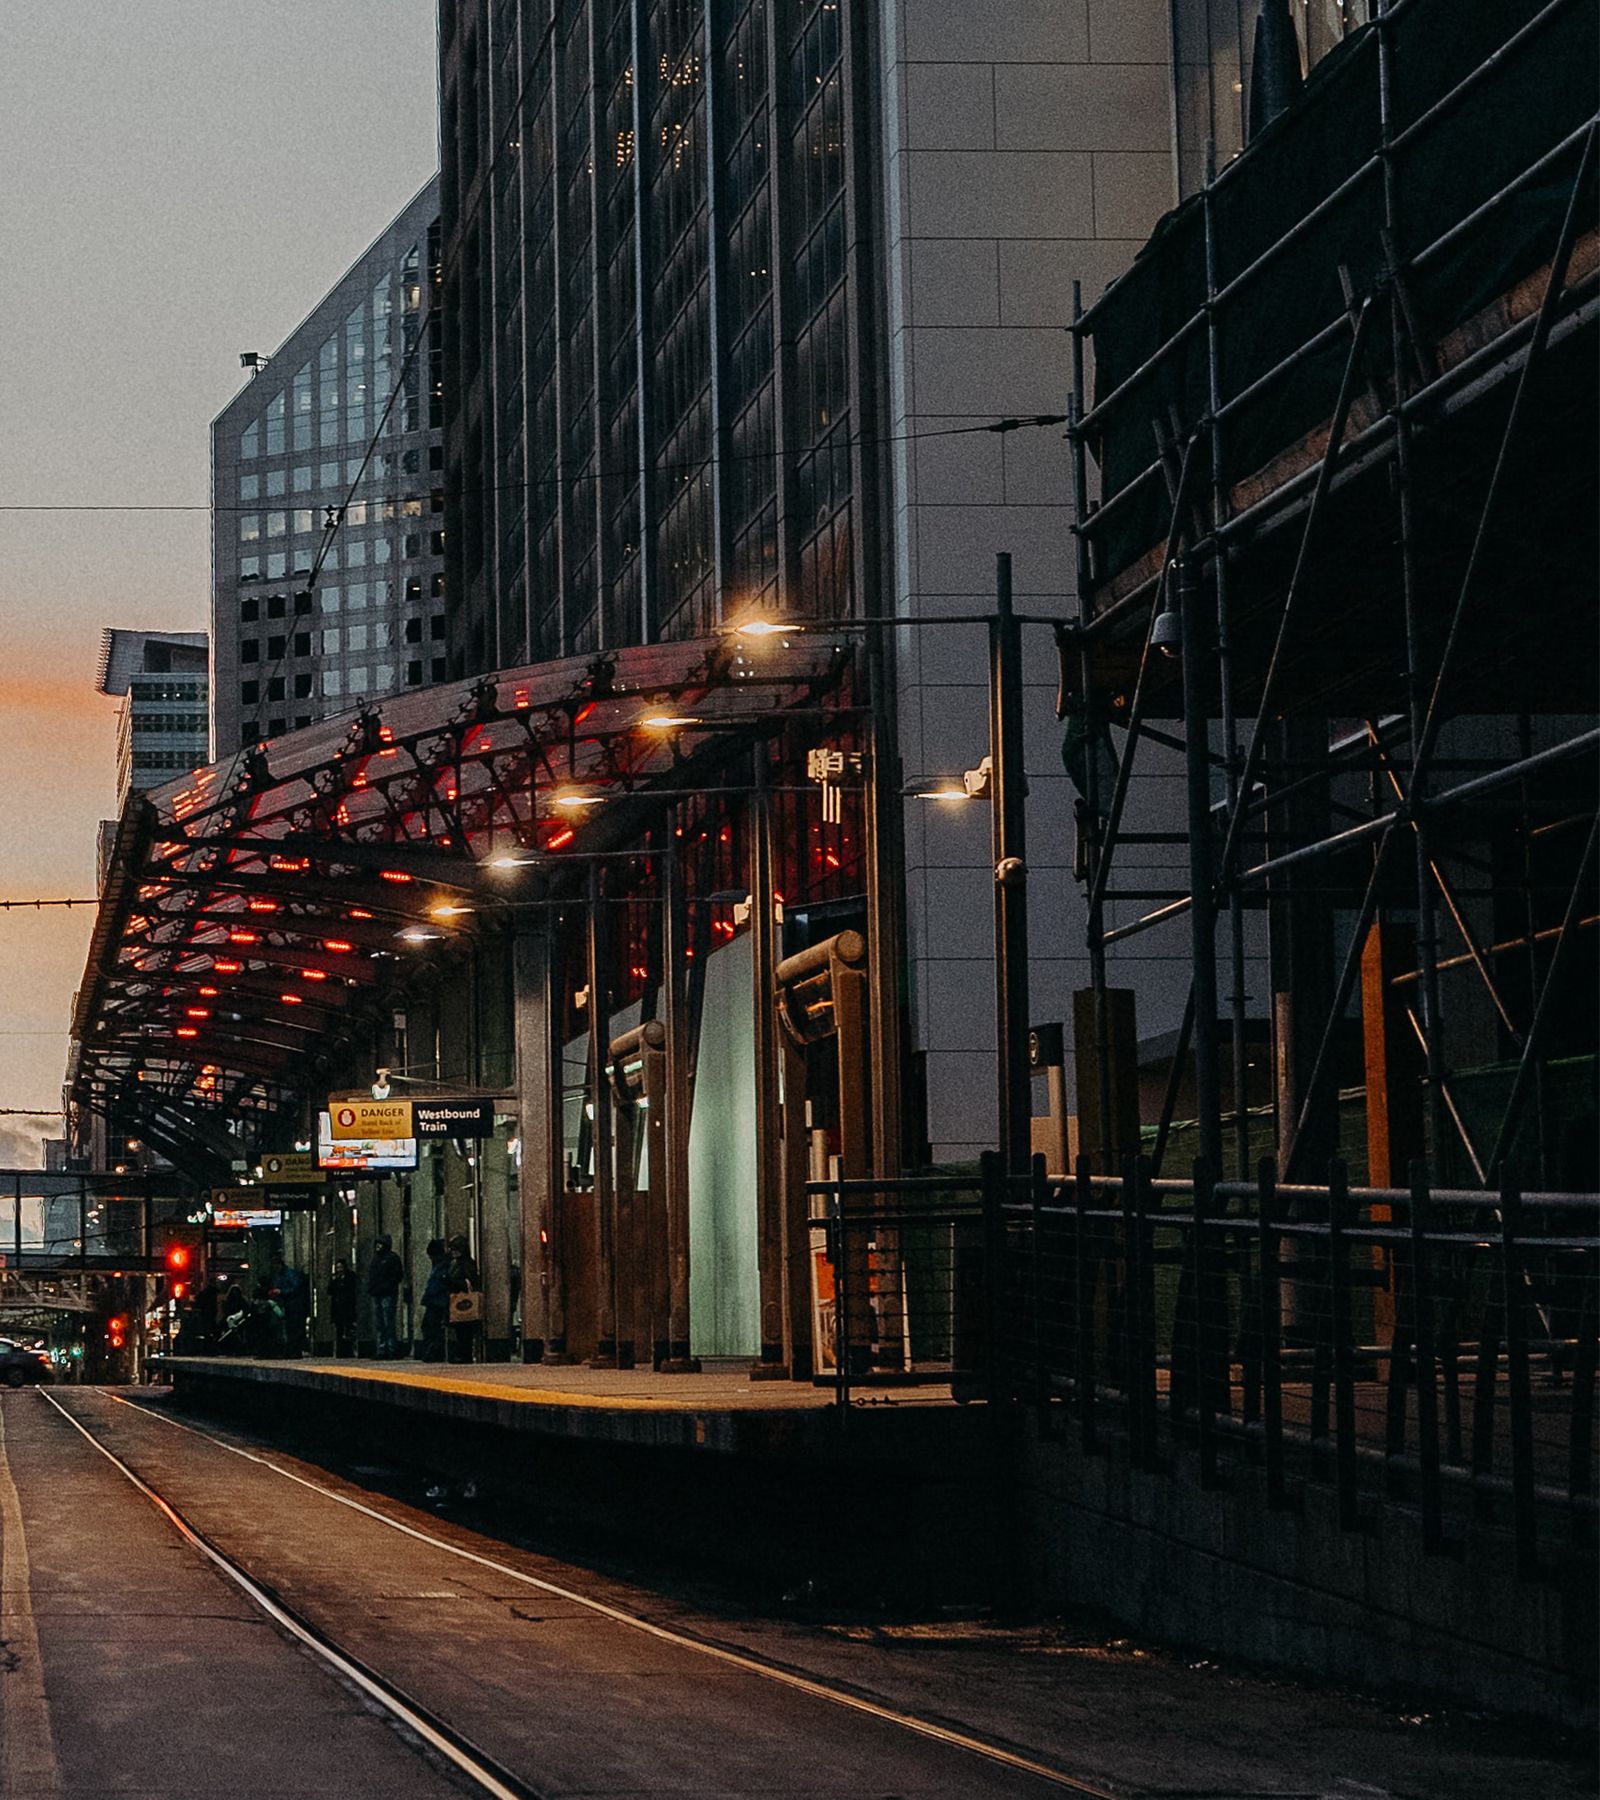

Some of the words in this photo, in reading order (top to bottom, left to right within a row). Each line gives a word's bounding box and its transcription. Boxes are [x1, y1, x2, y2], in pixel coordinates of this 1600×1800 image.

[361, 1108, 404, 1117] DANGER
[418, 1108, 480, 1120] Westbound
[419, 1121, 448, 1132] Train
